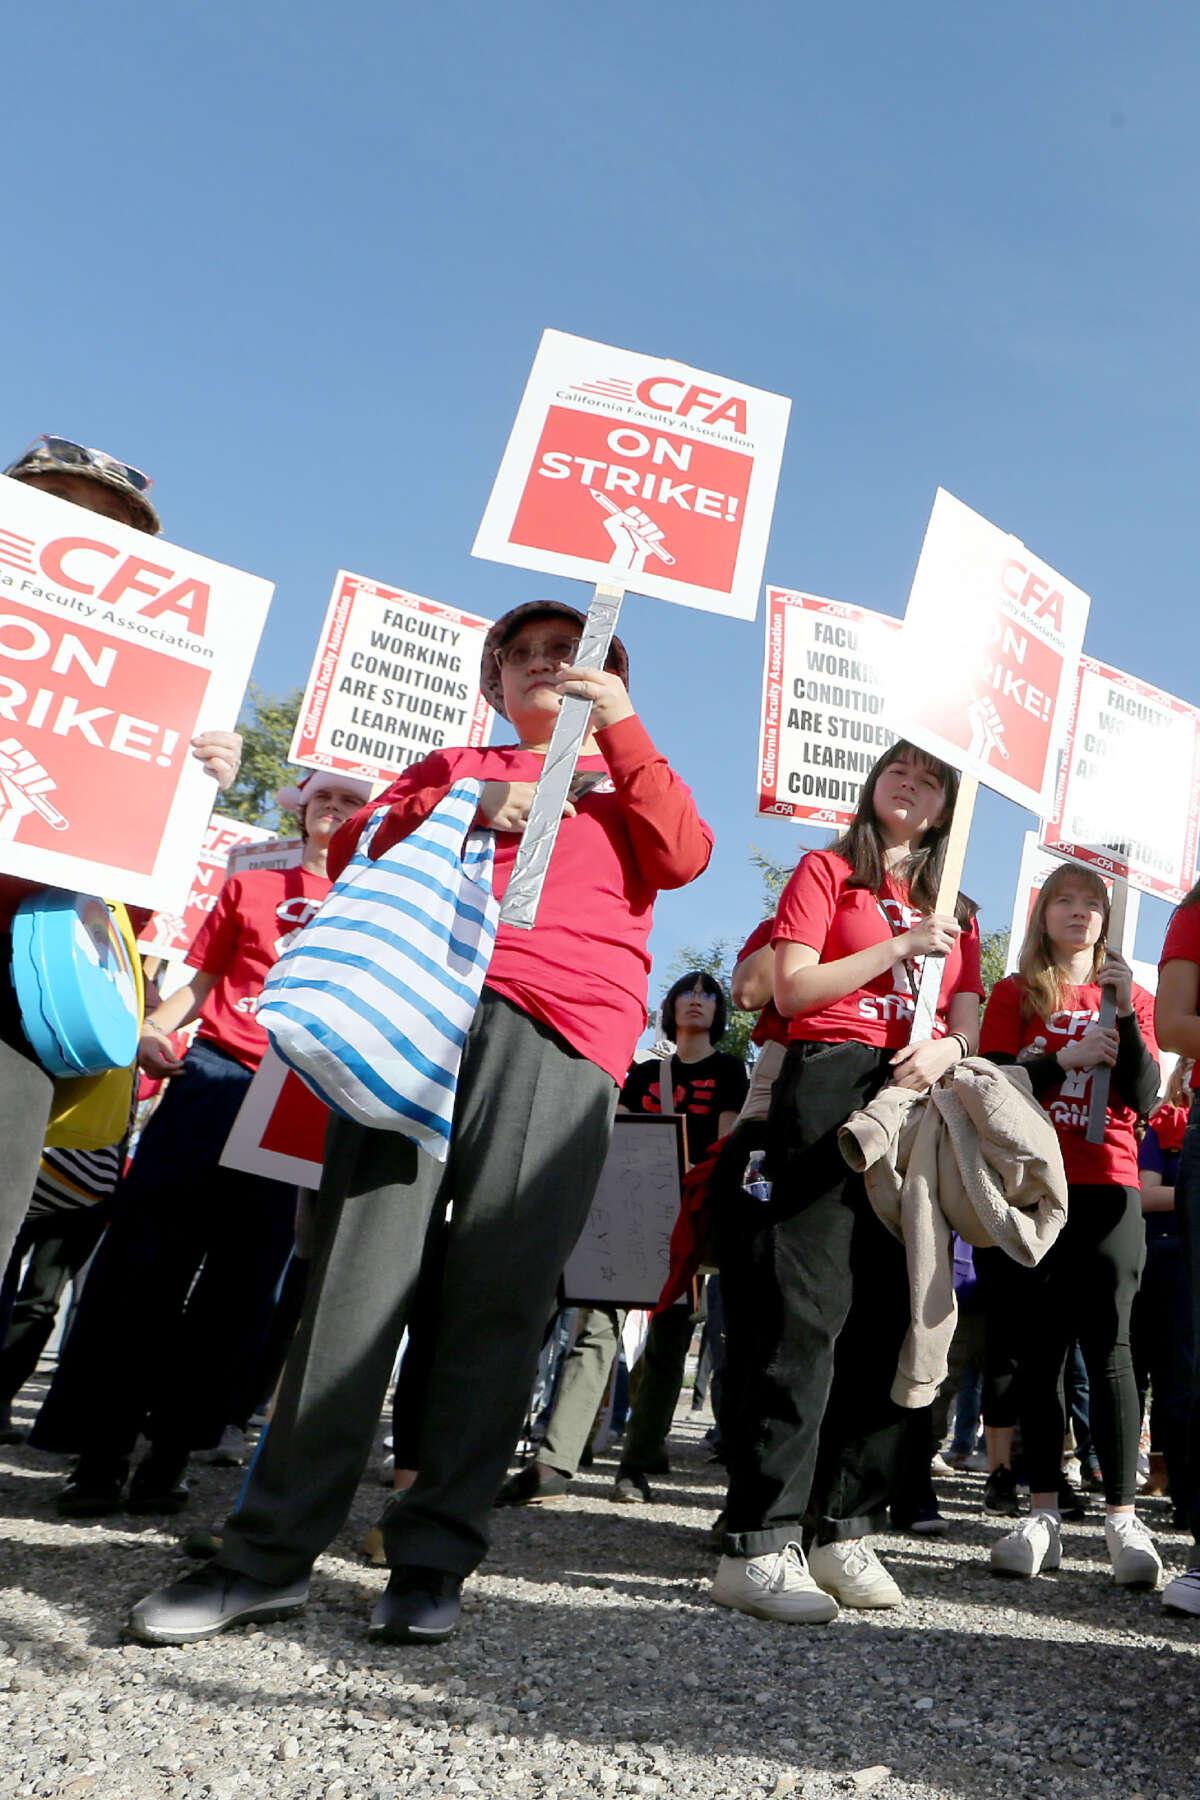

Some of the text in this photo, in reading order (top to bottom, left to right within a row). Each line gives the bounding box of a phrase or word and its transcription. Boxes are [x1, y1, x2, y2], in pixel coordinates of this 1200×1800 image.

[555, 390, 755, 449] California Faculty Association
[636, 376, 747, 435] CFA
[607, 428, 693, 472] ON
[537, 451, 739, 523] STRIKE!
[39, 536, 212, 637] CFA
[783, 593, 848, 618] CFA CFA
[1002, 558, 1066, 633] CFA
[20, 578, 215, 659] Faculty Association
[382, 608, 461, 647] FACULTY
[814, 621, 859, 651] FACU
[1019, 608, 1067, 650] Association
[0, 613, 118, 689] ON
[369, 630, 462, 673] WORKING
[1000, 624, 1028, 665] N
[303, 595, 352, 740] California Faculty Association
[350, 651, 469, 701] CONDITIONS
[981, 654, 1052, 723] RIKE!
[338, 676, 468, 726] ARE STUDENT
[762, 613, 783, 788] California Faculty Association
[793, 677, 885, 717] CONDITIO
[0, 676, 180, 768] RIKE!
[350, 706, 445, 747] LEARNING
[787, 707, 902, 748] ARE STUDEN
[312, 753, 380, 778] CFA CFA
[330, 728, 427, 767] CONDITIO
[803, 742, 878, 775] LEARNIN
[787, 771, 860, 804] CONDIT
[774, 802, 838, 823] CFA CFA
[1058, 842, 1076, 856] CFA
[1096, 857, 1115, 872] CFA
[1136, 872, 1153, 887] CFA
